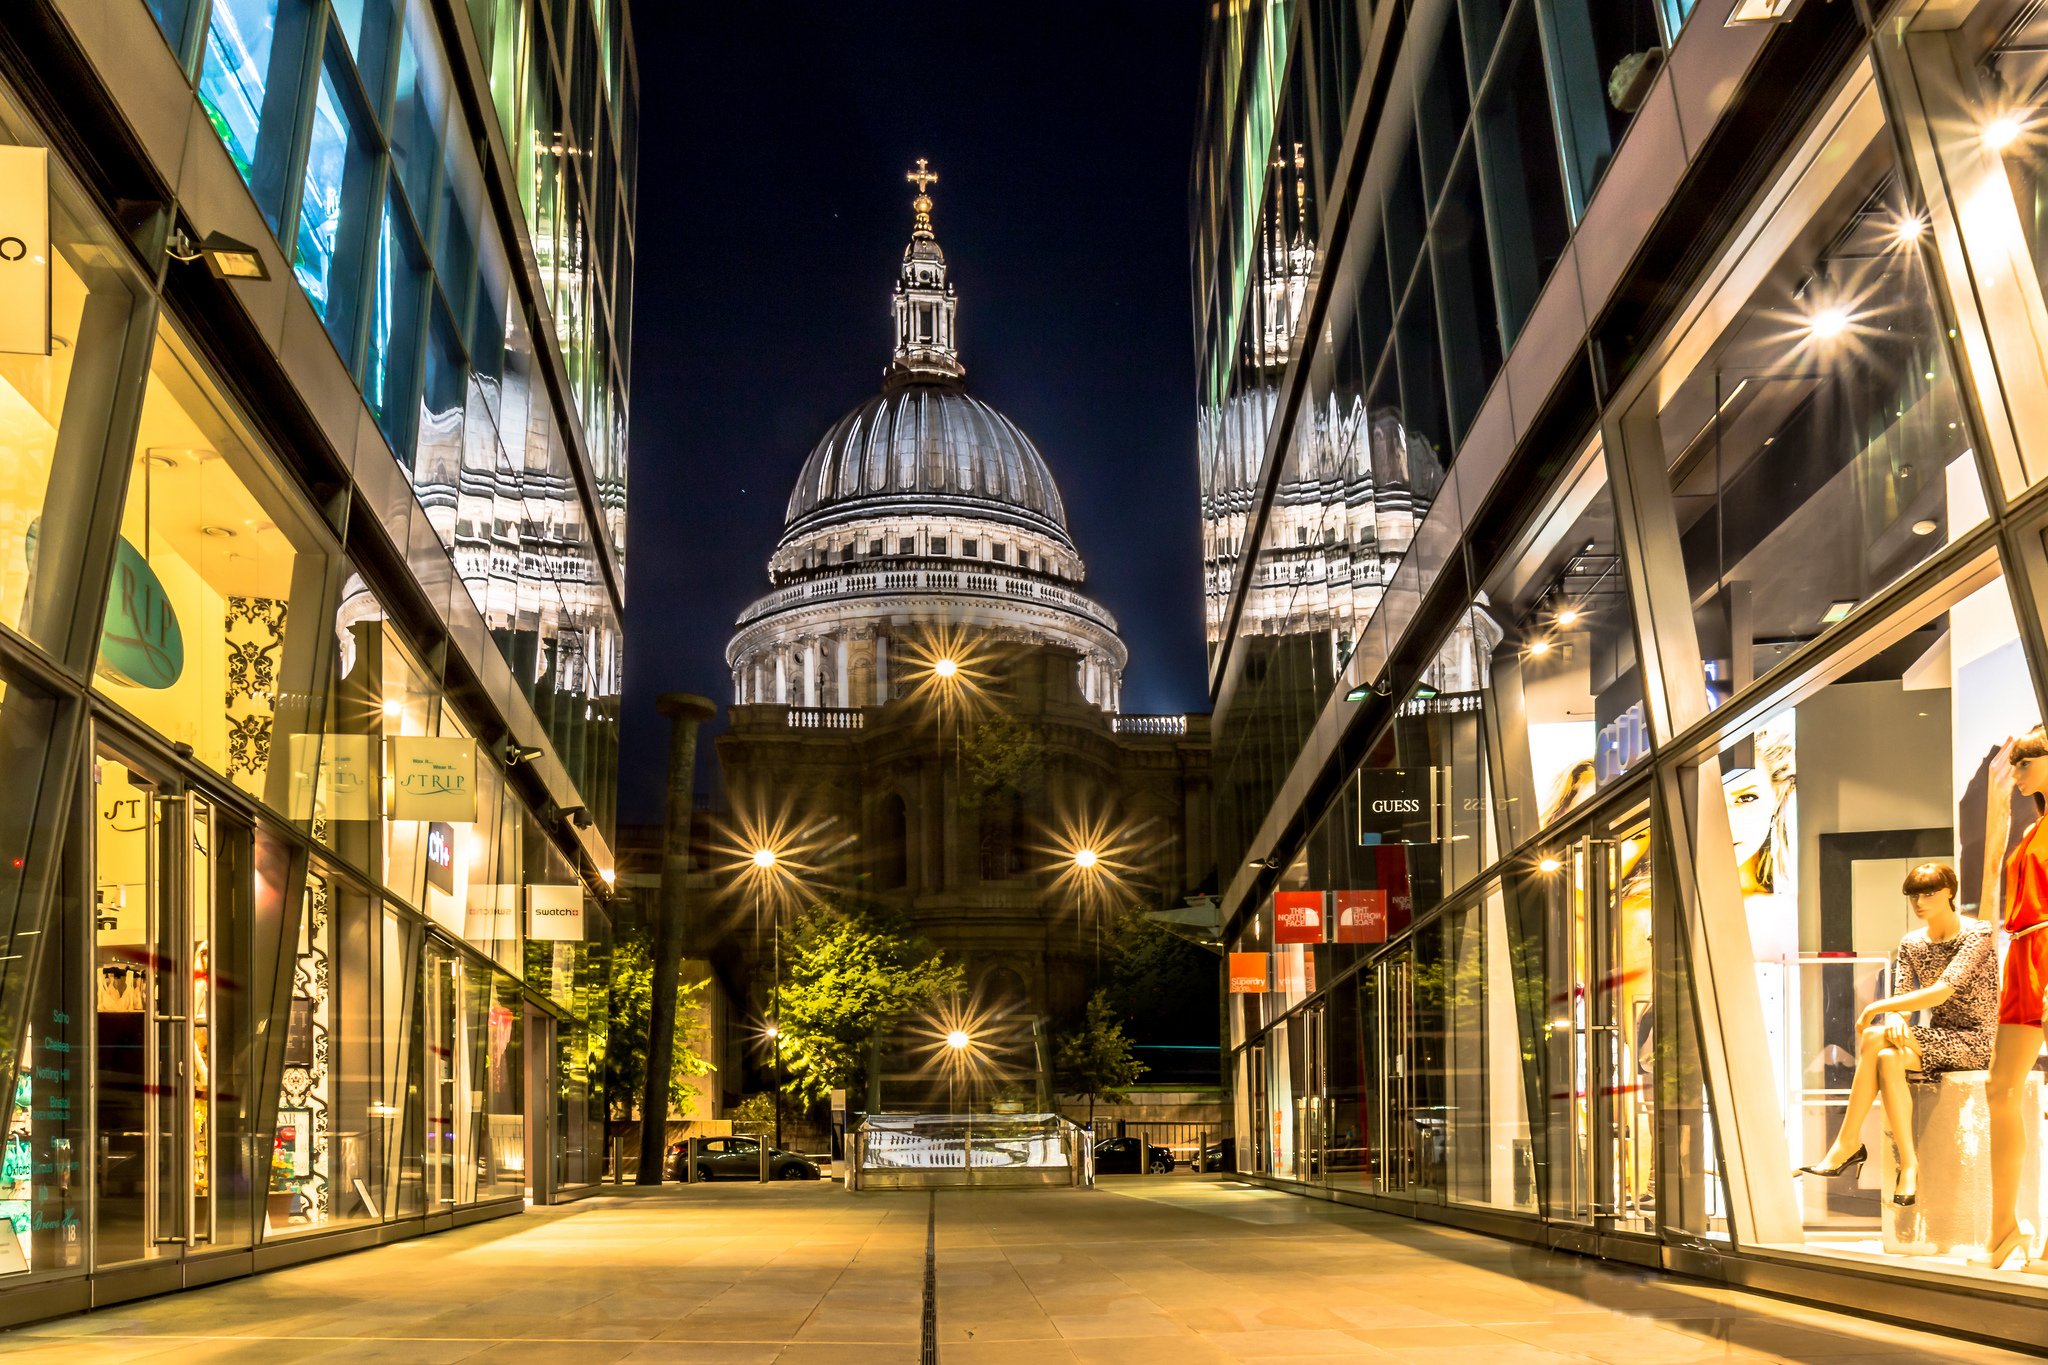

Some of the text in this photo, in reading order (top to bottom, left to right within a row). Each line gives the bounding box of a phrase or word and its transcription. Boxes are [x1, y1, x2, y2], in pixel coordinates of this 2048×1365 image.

[401, 774, 466, 795] STRIP
[1372, 799, 1420, 813] GUESS
[535, 908, 572, 917] swatch
[1231, 976, 1266, 987] Superdry
[53, 1009, 70, 1025] Soho
[35, 1065, 71, 1084] Notting Hill
